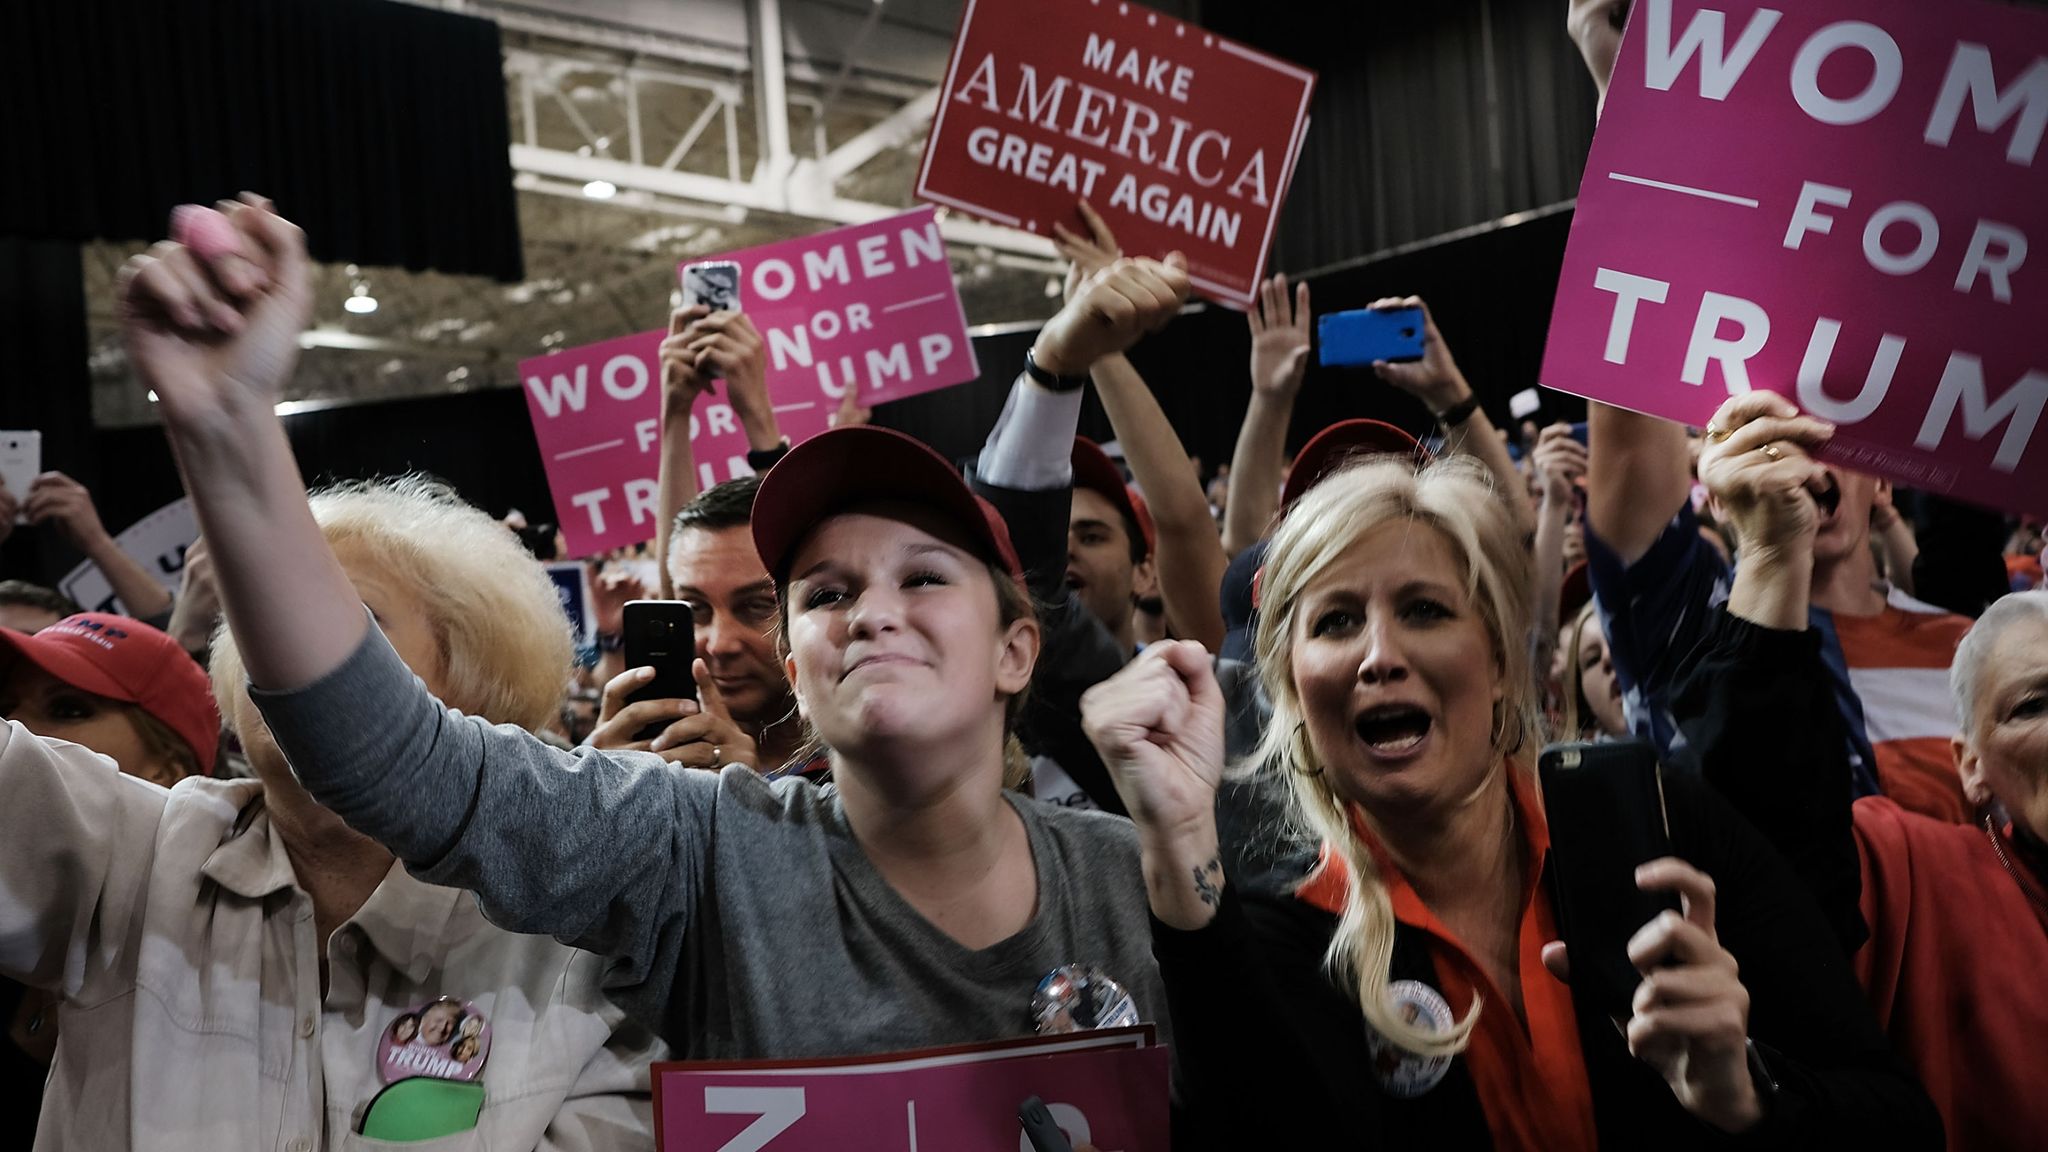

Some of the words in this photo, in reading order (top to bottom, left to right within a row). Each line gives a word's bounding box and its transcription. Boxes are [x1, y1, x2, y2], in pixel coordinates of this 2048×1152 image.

[1082, 32, 1194, 103] MAKE
[955, 52, 1270, 208] AMERICA
[967, 126, 1106, 198] GREAT
[1109, 174, 1242, 249] AGAIN
[752, 223, 944, 300] OMEN
[1783, 180, 2029, 304] FOR
[811, 303, 873, 340] OR
[527, 324, 814, 418] WON
[816, 333, 953, 399] UMP
[386, 1046, 464, 1079] TRUMP
